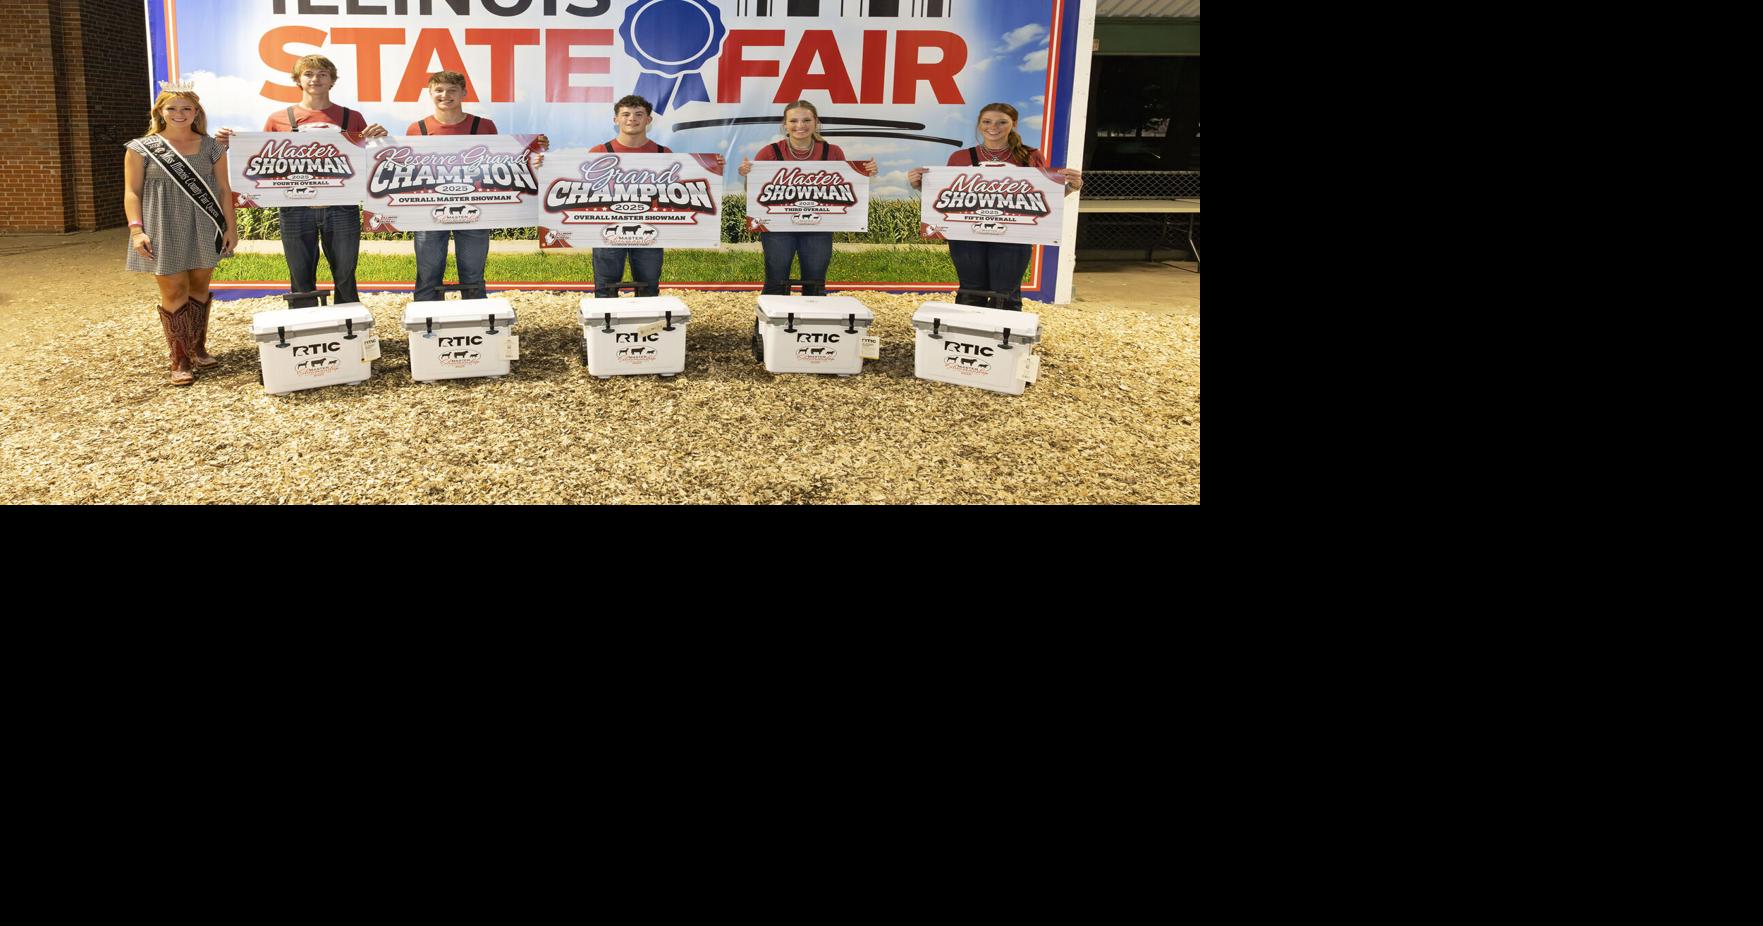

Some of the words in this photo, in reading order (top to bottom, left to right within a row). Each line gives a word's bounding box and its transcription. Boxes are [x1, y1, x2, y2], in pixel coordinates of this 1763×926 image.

[258, 25, 614, 103] STATE
[716, 29, 969, 104] FAIR
[260, 140, 338, 158] Master
[376, 146, 458, 171] Reserve
[461, 145, 530, 172] Grand
[246, 155, 353, 176] SHOWMAN
[581, 156, 681, 191] Grand
[369, 160, 539, 194] CHAMPION
[773, 168, 841, 186] Master
[951, 174, 1032, 194] Master
[546, 180, 713, 209] CHAMPION
[760, 184, 855, 202] SHOWMAN
[935, 190, 1049, 213] SHOWMAN
[438, 336, 483, 347] RTIC
[796, 333, 841, 343] RTIC
[293, 342, 341, 357] RTIC
[944, 341, 994, 357] RTIC
